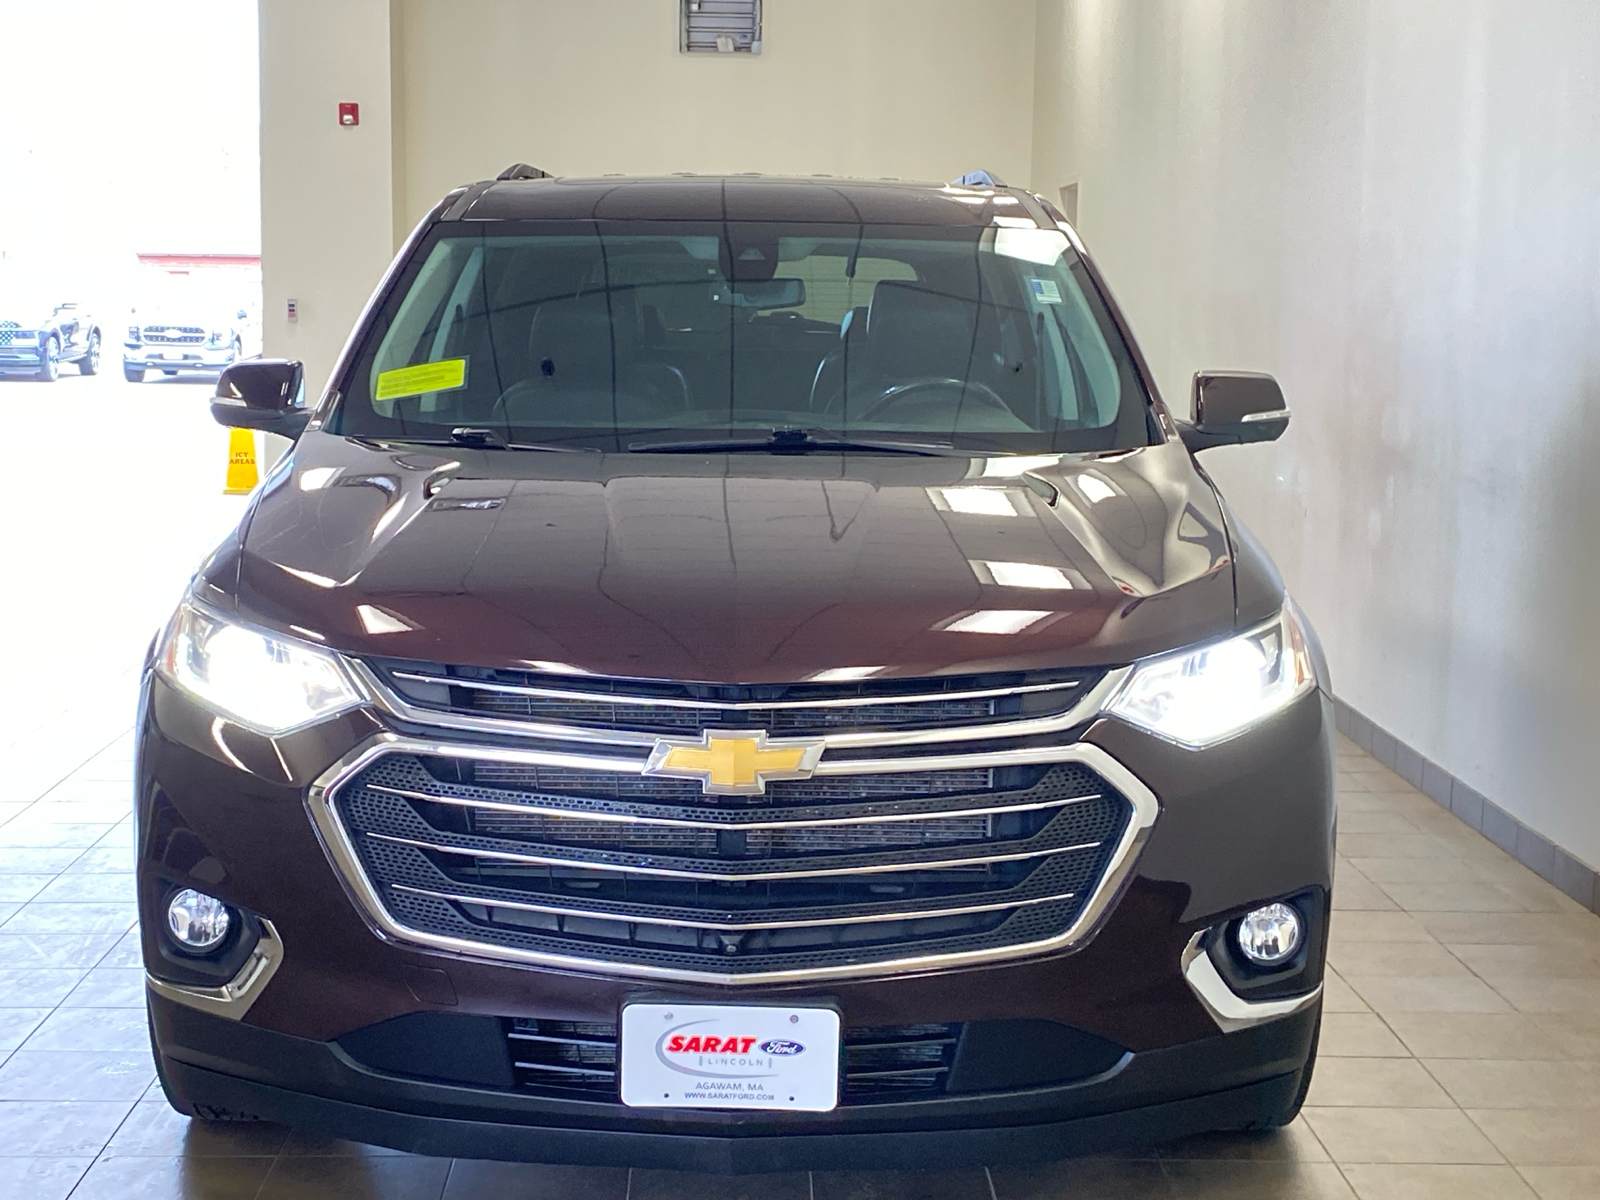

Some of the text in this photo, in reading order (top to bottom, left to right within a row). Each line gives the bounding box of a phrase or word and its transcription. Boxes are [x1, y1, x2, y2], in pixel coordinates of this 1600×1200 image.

[666, 1035, 798, 1054] SARAT Ford
[708, 1058, 764, 1066] LINCOLN
[695, 1082, 764, 1091] AGAWAM, MA
[684, 1092, 775, 1101] WWW.SARATFORD.COM
